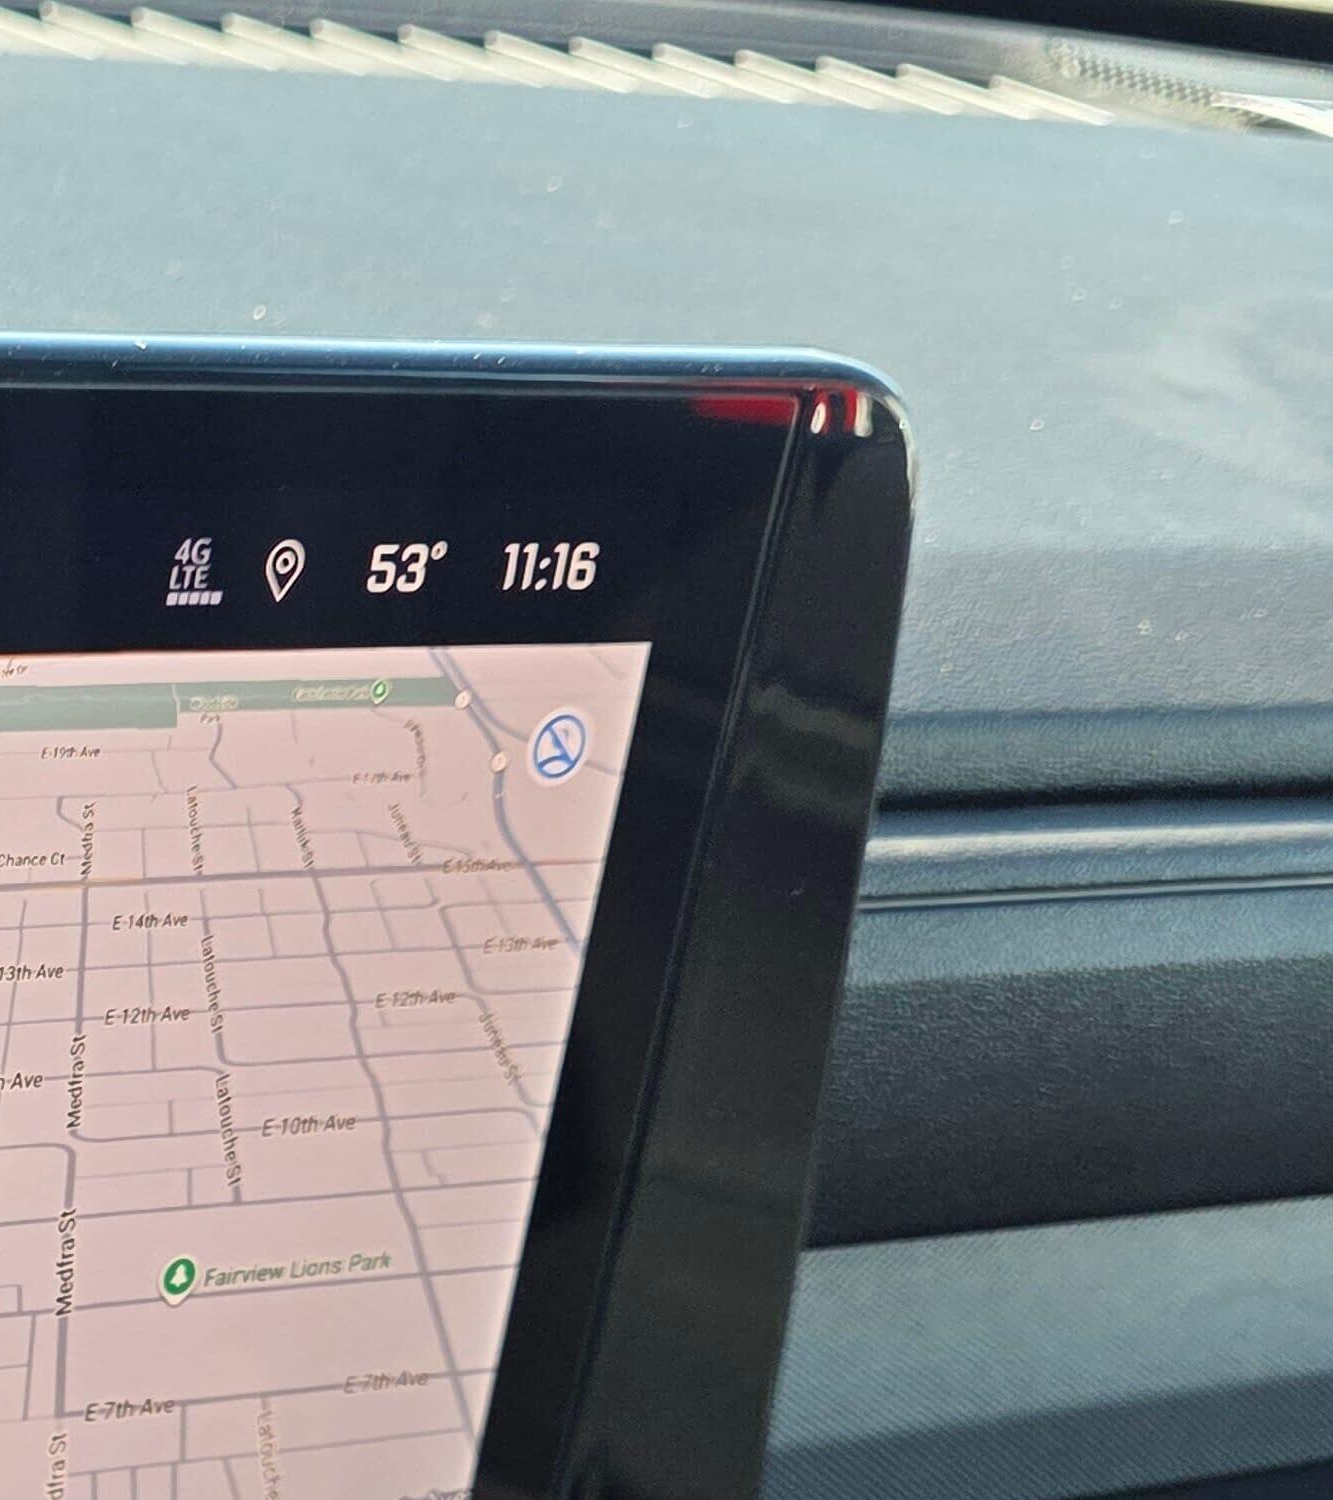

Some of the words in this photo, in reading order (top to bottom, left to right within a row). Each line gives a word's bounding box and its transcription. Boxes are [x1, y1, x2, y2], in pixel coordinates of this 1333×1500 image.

[174, 537, 212, 565] 4G
[169, 564, 210, 590] LTE
[366, 541, 448, 593] 53°
[502, 541, 600, 591] 11:16
[41, 746, 50, 759] E
[80, 745, 101, 758] Ave
[82, 802, 96, 821] St
[112, 915, 122, 931] E
[123, 914, 159, 930] 14th
[160, 913, 189, 928] Ave
[35, 964, 64, 979] Ave
[201, 935, 220, 1012] Latouche
[374, 992, 385, 1008] E
[427, 990, 457, 1005] Ave
[104, 1009, 115, 1025] E
[119, 1007, 157, 1024] 12th
[160, 1005, 190, 1021] Ave
[210, 1013, 223, 1034] St
[70, 1034, 86, 1055] St
[11, 1074, 43, 1090] Ave
[66, 1059, 85, 1128] Medfra
[214, 1073, 239, 1164] Latouche
[261, 1118, 275, 1137] E
[277, 1116, 319, 1136] 10th
[323, 1115, 357, 1133] Ave
[226, 1164, 241, 1188] St
[57, 1208, 77, 1233] St
[56, 1238, 75, 1316] Medfra
[204, 1264, 284, 1289] Fairview
[290, 1257, 342, 1280] Lions
[347, 1251, 392, 1272] Park
[343, 1376, 356, 1394] E
[394, 1370, 430, 1388] Ave
[85, 1404, 97, 1421] E
[102, 1401, 134, 1420] 7th
[139, 1398, 175, 1416] Ave
[47, 1433, 68, 1458] St
